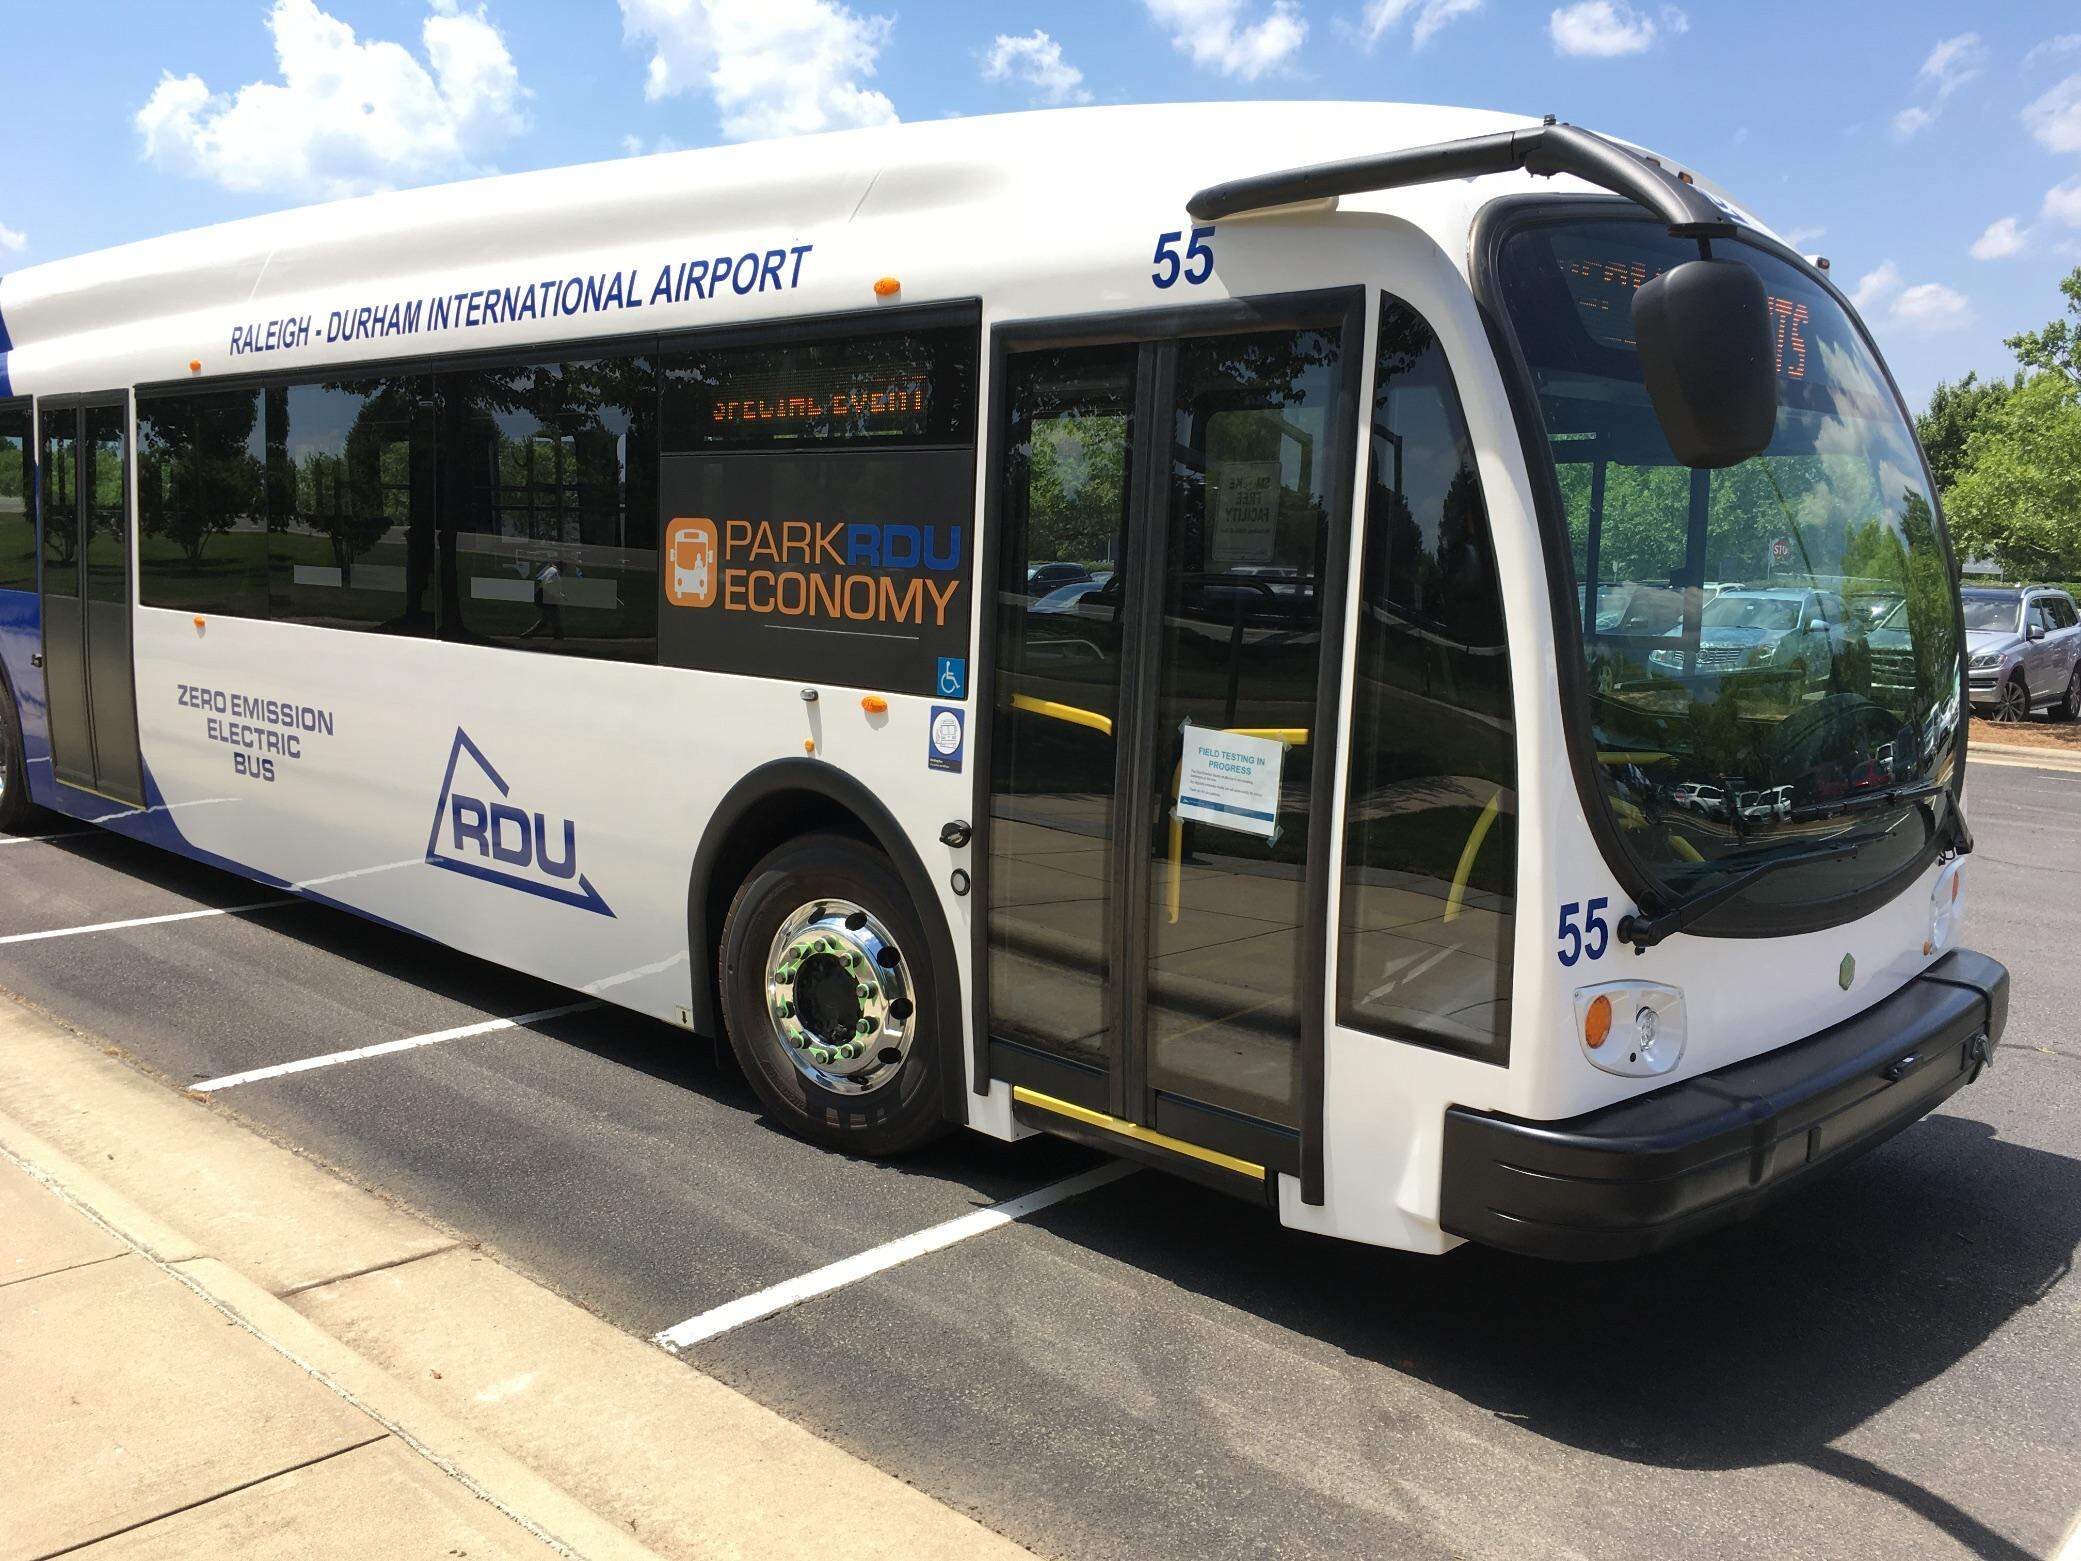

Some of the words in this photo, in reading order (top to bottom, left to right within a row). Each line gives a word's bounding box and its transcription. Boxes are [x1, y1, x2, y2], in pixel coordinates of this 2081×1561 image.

[1152, 226, 1216, 289] 55
[229, 315, 309, 356] RALEIGH
[326, 301, 422, 344] DURHAM
[426, 269, 643, 331] INTERNATIONAL
[648, 244, 813, 304] AIRPORT
[1773, 544, 1788, 555] STO
[724, 568, 960, 626] ECONOMY
[177, 684, 227, 714] ZERO
[230, 693, 334, 736] EMISSION
[206, 717, 301, 758] ELECTRIC
[1198, 747, 1220, 758] FIELD
[1221, 751, 1255, 764] TESTING
[1256, 758, 1265, 766] IN
[233, 751, 275, 782] BUS
[1208, 760, 1252, 775] PROGRESS
[451, 793, 577, 879] RDU
[1557, 896, 1608, 967] 55
